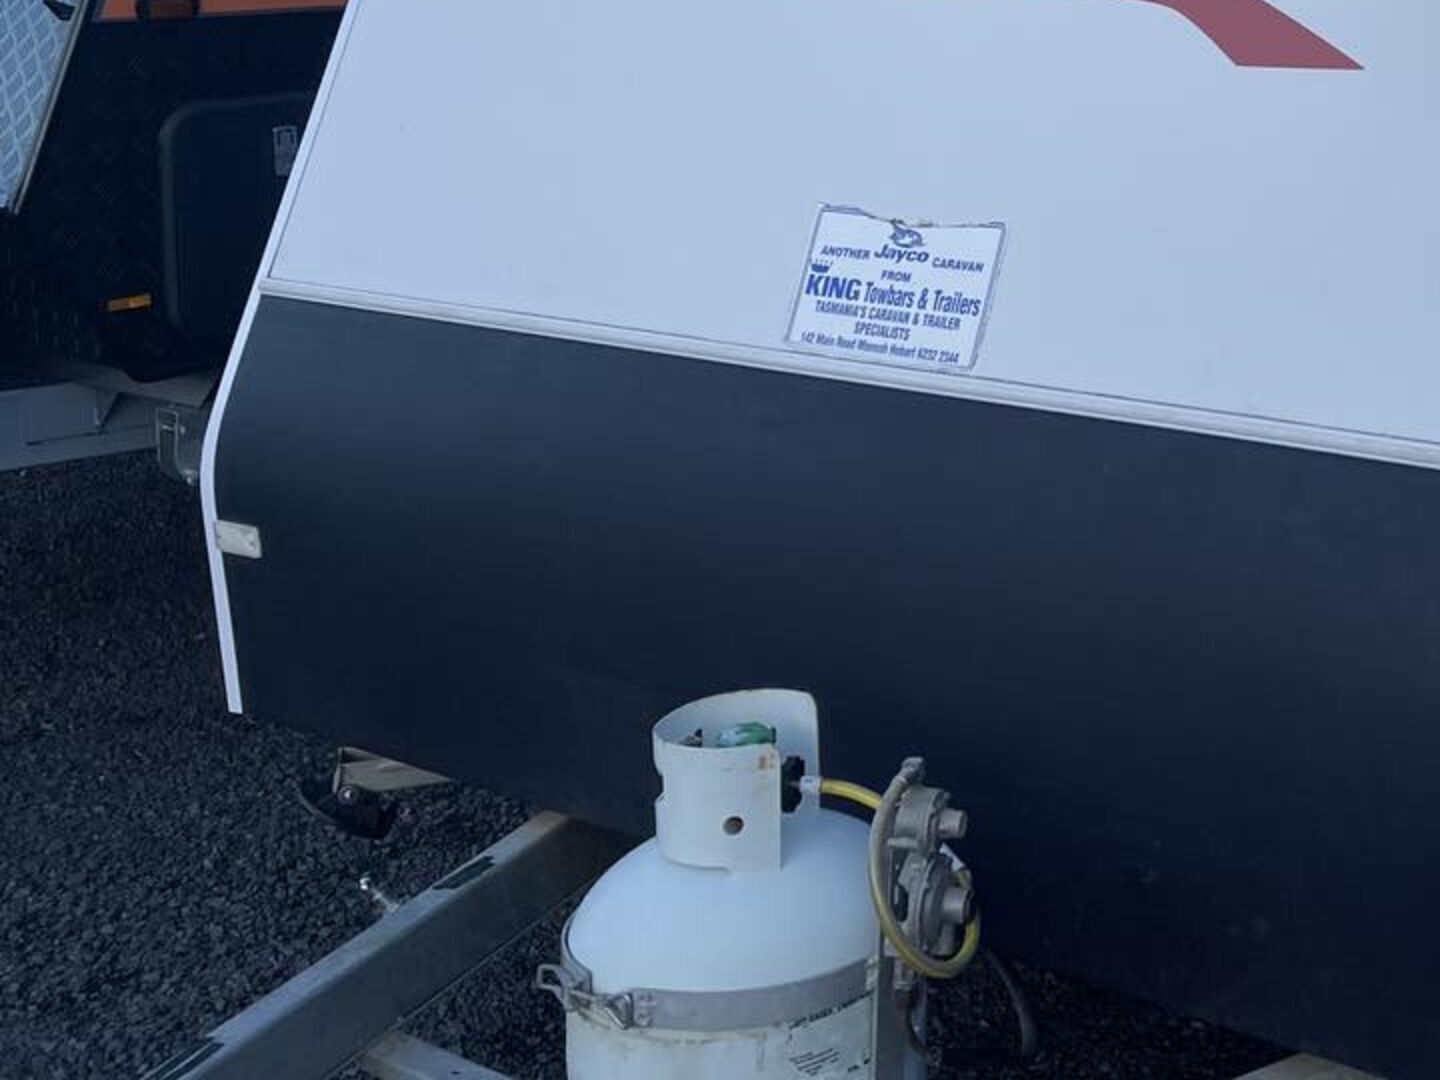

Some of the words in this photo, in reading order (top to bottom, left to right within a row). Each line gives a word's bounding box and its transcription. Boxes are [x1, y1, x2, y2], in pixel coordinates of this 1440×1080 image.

[819, 245, 870, 261] ANOTHER
[874, 244, 930, 264] Jayco
[931, 257, 984, 273] CARAVAN
[880, 270, 912, 283] FROM
[805, 274, 862, 301] KING
[863, 281, 915, 308] Towbars
[917, 288, 929, 310] &
[932, 289, 981, 317] Trailers
[815, 300, 867, 319] TASMANIA'S
[868, 306, 911, 325] CARAVAN
[911, 313, 919, 326] &
[921, 313, 961, 331] TRAILER
[816, 333, 835, 346] Main
[837, 336, 857, 350] Road
[854, 322, 911, 341] SPECIALISTS
